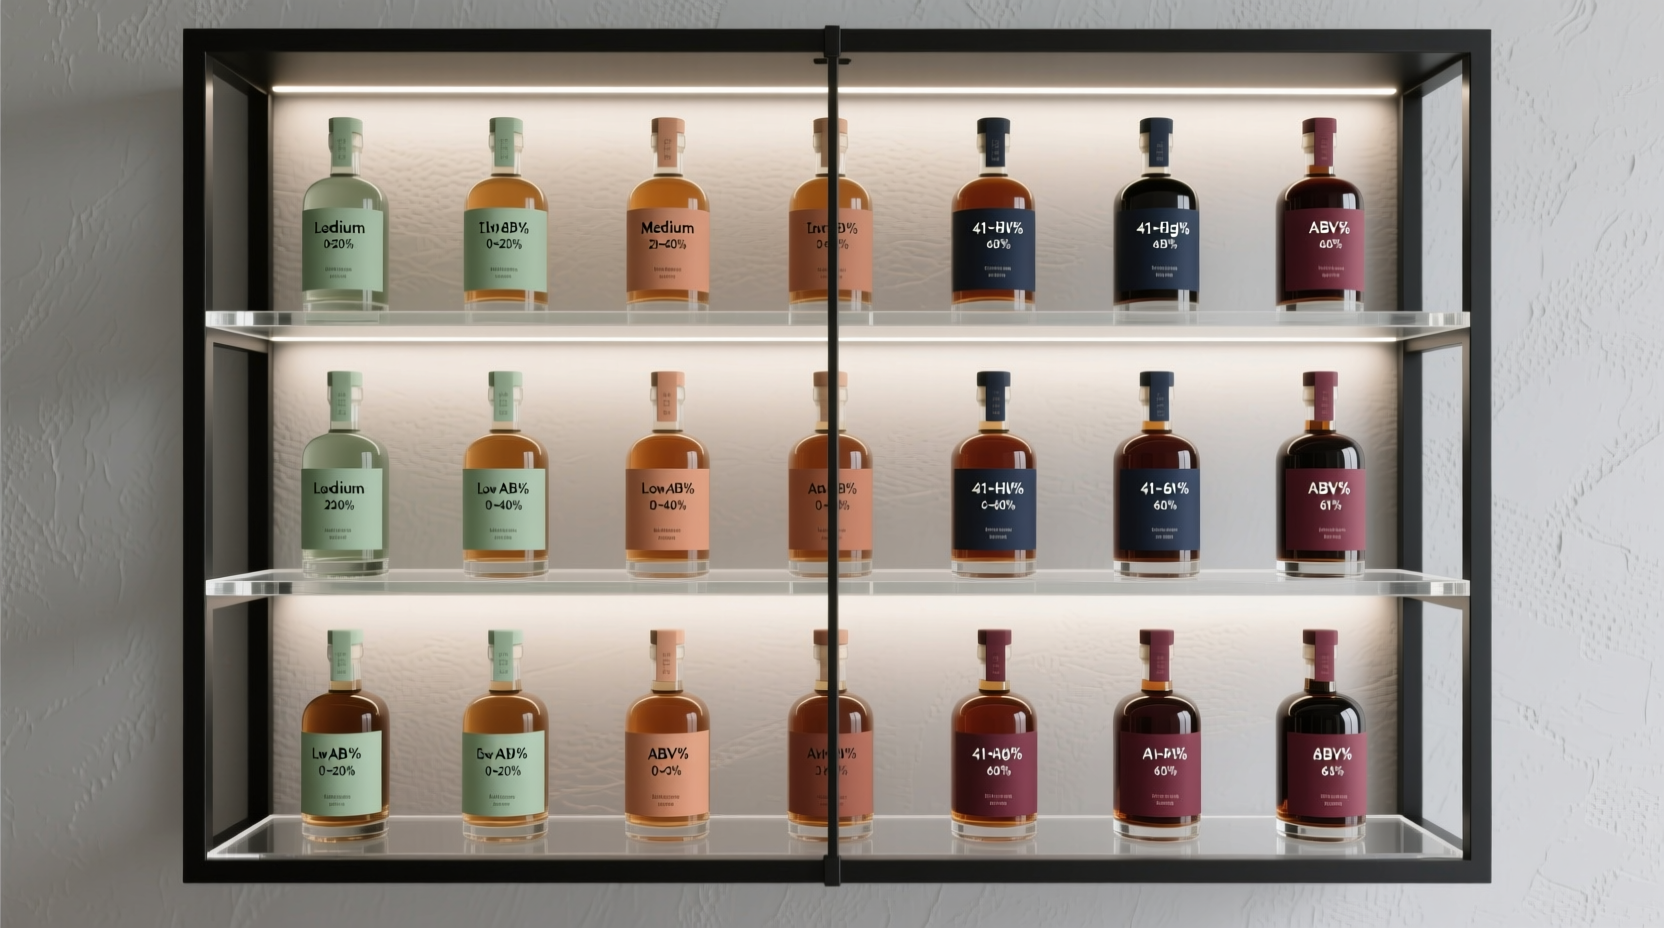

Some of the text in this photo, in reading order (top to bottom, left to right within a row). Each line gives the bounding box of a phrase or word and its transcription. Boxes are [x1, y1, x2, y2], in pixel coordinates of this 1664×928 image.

[641, 220, 695, 234] Medium
[1308, 481, 1351, 495] ABV%
[485, 499, 523, 510] 0-40%
[649, 499, 687, 510] 0-40%
[1153, 499, 1177, 510] 60%
[648, 747, 689, 761] ABV%
[318, 764, 356, 776] 0-20%
[485, 765, 522, 776] 0-20%
[986, 764, 1011, 776] 60%
